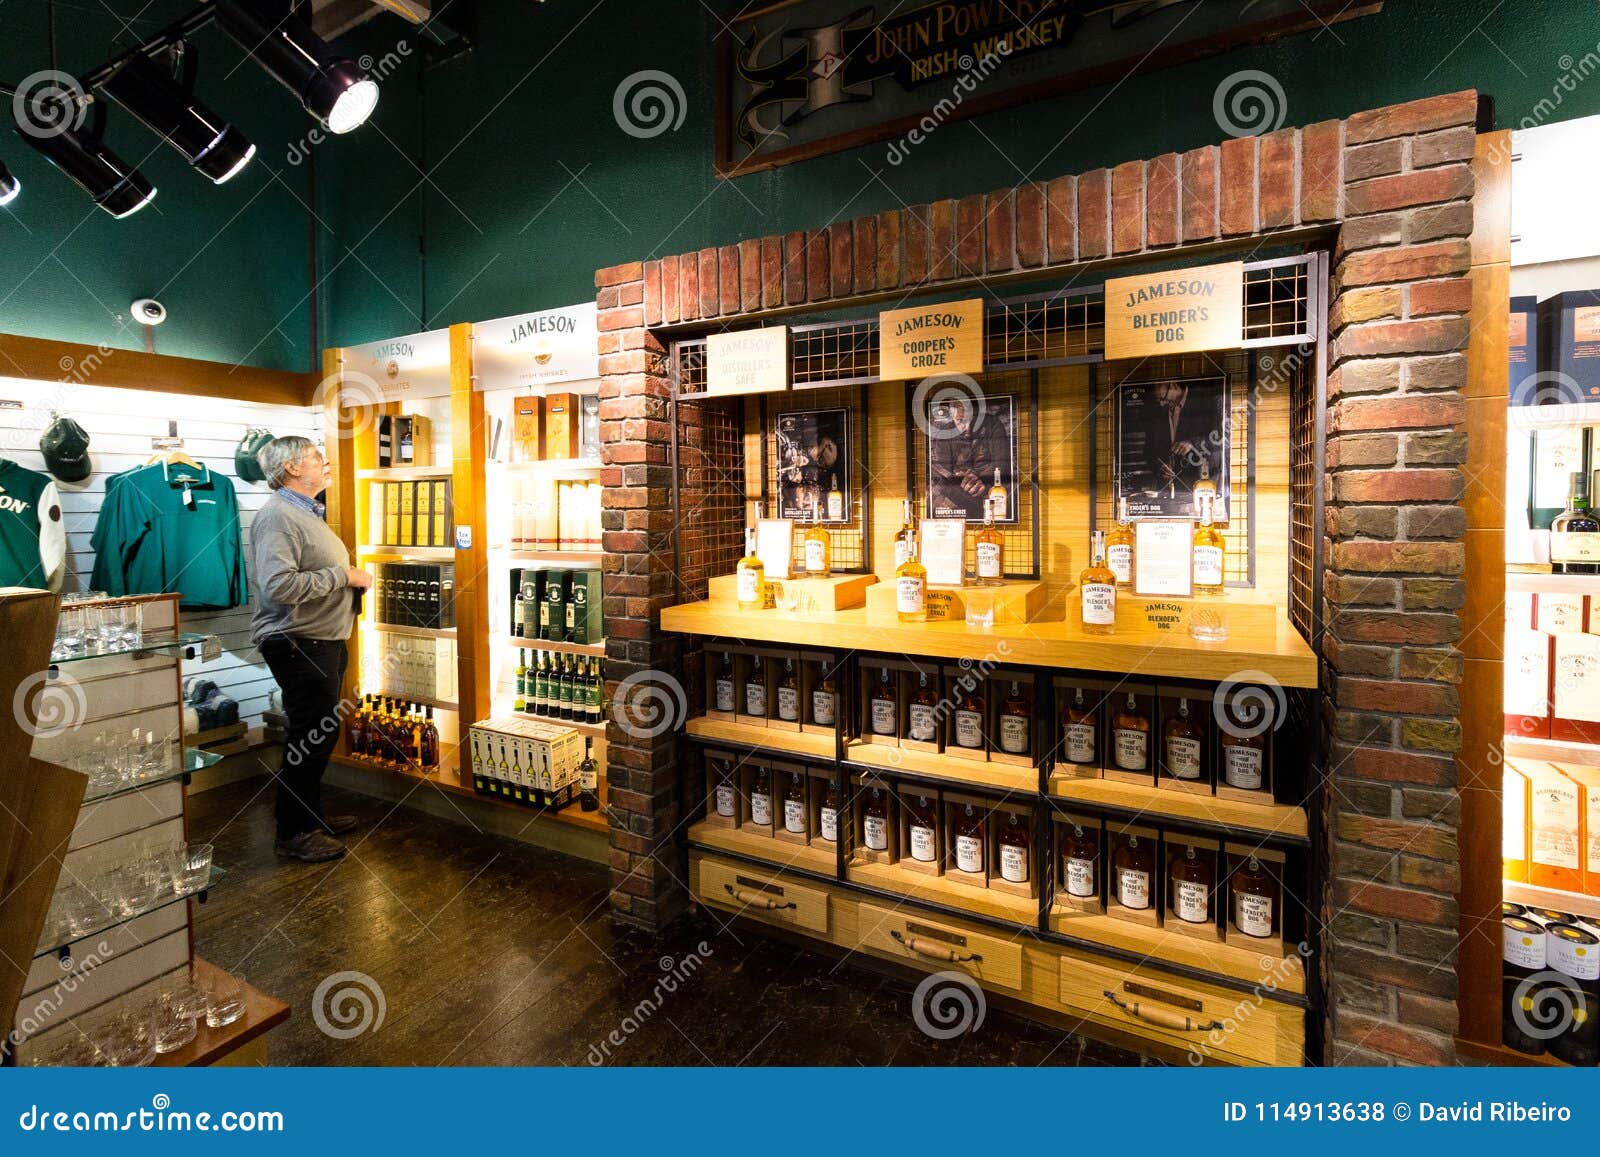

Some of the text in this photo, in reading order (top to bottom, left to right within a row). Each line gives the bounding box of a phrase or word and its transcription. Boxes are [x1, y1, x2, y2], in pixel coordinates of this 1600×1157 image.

[865, 16, 931, 64] JOHN
[911, 48, 959, 82] IRISH
[972, 16, 1065, 60] WHISKEY
[1126, 280, 1215, 308] JAMESON
[1133, 306, 1209, 329] BLENDER'S
[510, 315, 577, 344] JAMESON
[896, 313, 963, 336] JAMESON
[1155, 327, 1184, 343] DOG
[903, 336, 955, 354] COOPER'S
[911, 352, 947, 368] CROZE
[1085, 585, 1112, 593] JAMESON
[927, 593, 953, 602] AMESON
[1144, 602, 1183, 613] JAMESON
[1147, 614, 1180, 623] BLENDER'S
[1157, 622, 1171, 630] DOG
[1118, 732, 1144, 740] JAMESON
[1168, 740, 1196, 749] JAMESON
[1229, 749, 1258, 757] JAMESON
[1119, 871, 1145, 880] JAMESON
[1177, 883, 1204, 892] JAMESON
[1240, 895, 1268, 905] JAMESON
